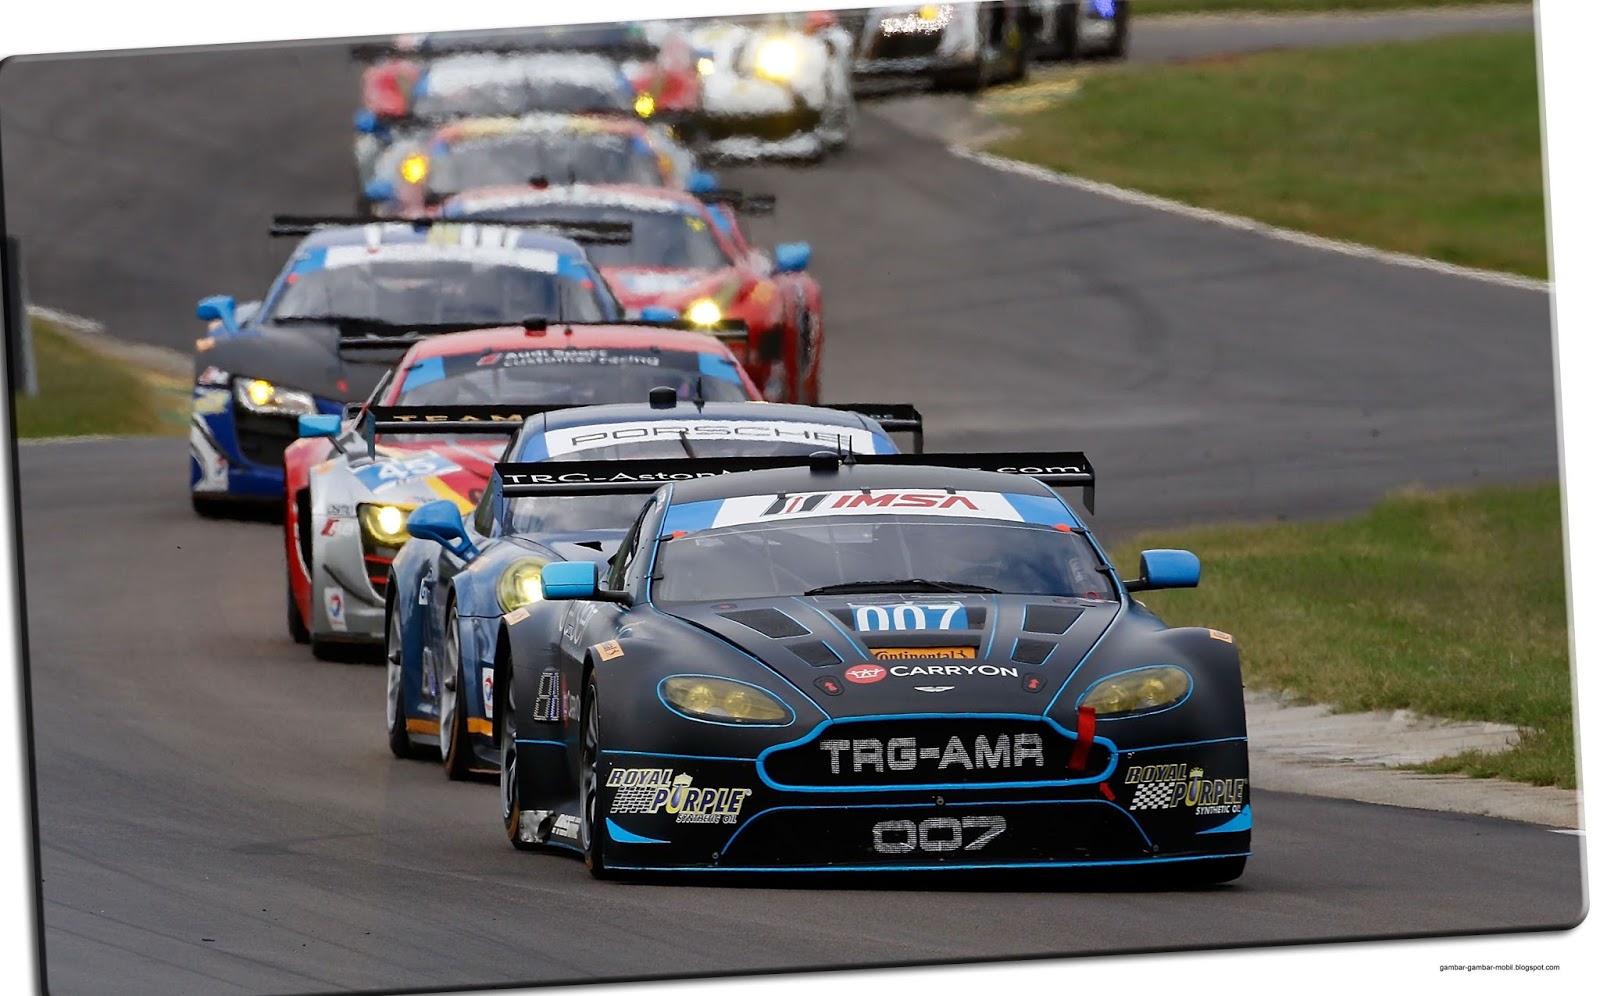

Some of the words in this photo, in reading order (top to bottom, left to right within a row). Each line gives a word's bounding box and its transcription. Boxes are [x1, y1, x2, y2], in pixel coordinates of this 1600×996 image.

[504, 351, 549, 359] Audi
[571, 425, 846, 446] PORSCHE
[830, 494, 979, 511] IMSA
[856, 605, 961, 631] 007
[890, 665, 1019, 678] CARRYON
[819, 733, 1045, 774] TRG-AMR
[606, 769, 673, 787] ROYAL
[1125, 764, 1187, 784] ROYAL
[1170, 779, 1244, 808] PURPLE
[676, 814, 721, 824] SYNTHETIC
[722, 814, 738, 824] OIL
[1195, 806, 1230, 815] SYNTHETIC
[873, 816, 1007, 854] 007
